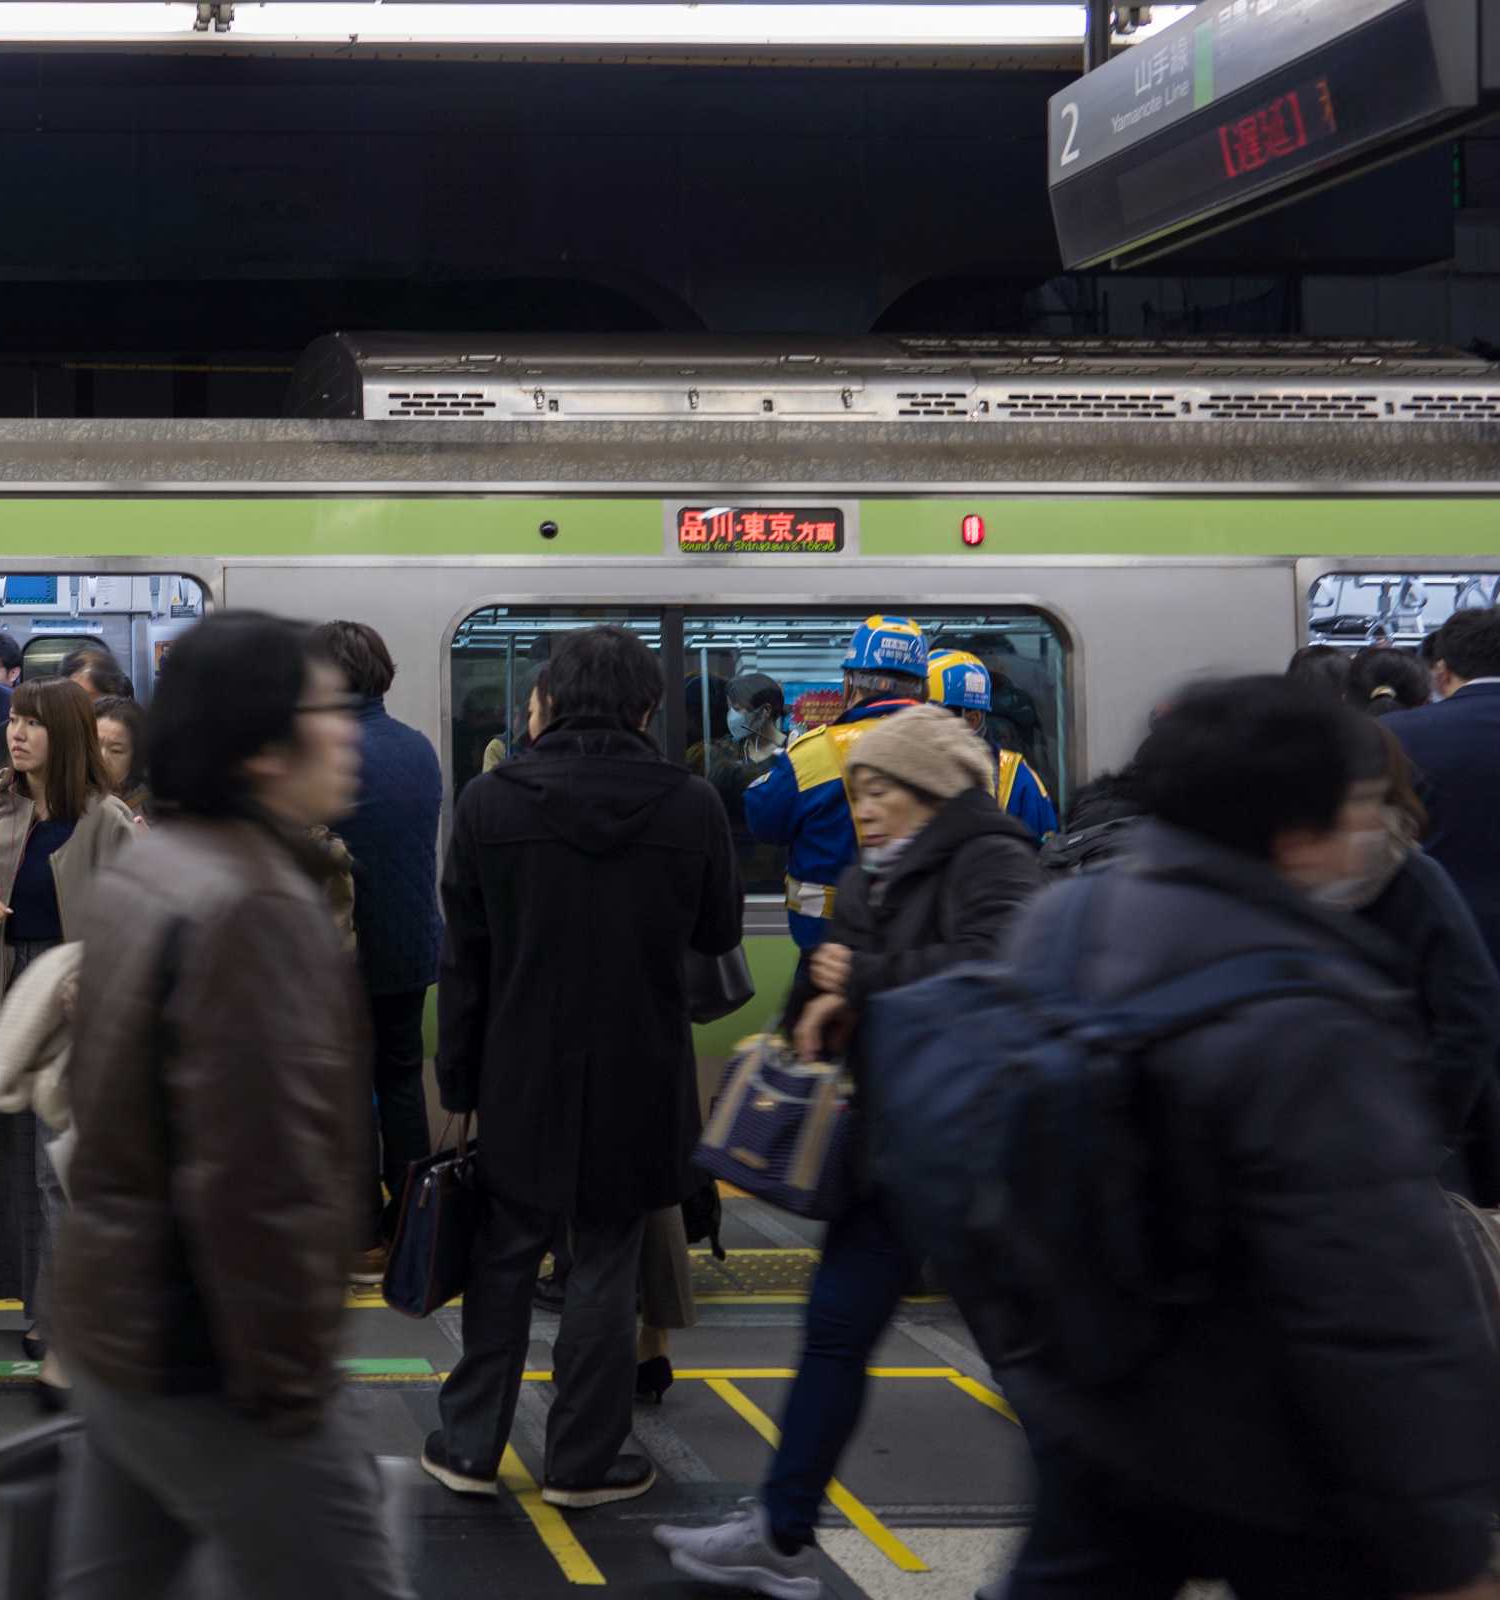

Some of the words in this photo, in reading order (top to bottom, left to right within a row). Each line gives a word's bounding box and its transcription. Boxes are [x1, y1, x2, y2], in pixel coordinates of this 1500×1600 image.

[1060, 103, 1080, 166] 2
[1111, 94, 1163, 134] Yamanote
[1165, 80, 1190, 107] Line
